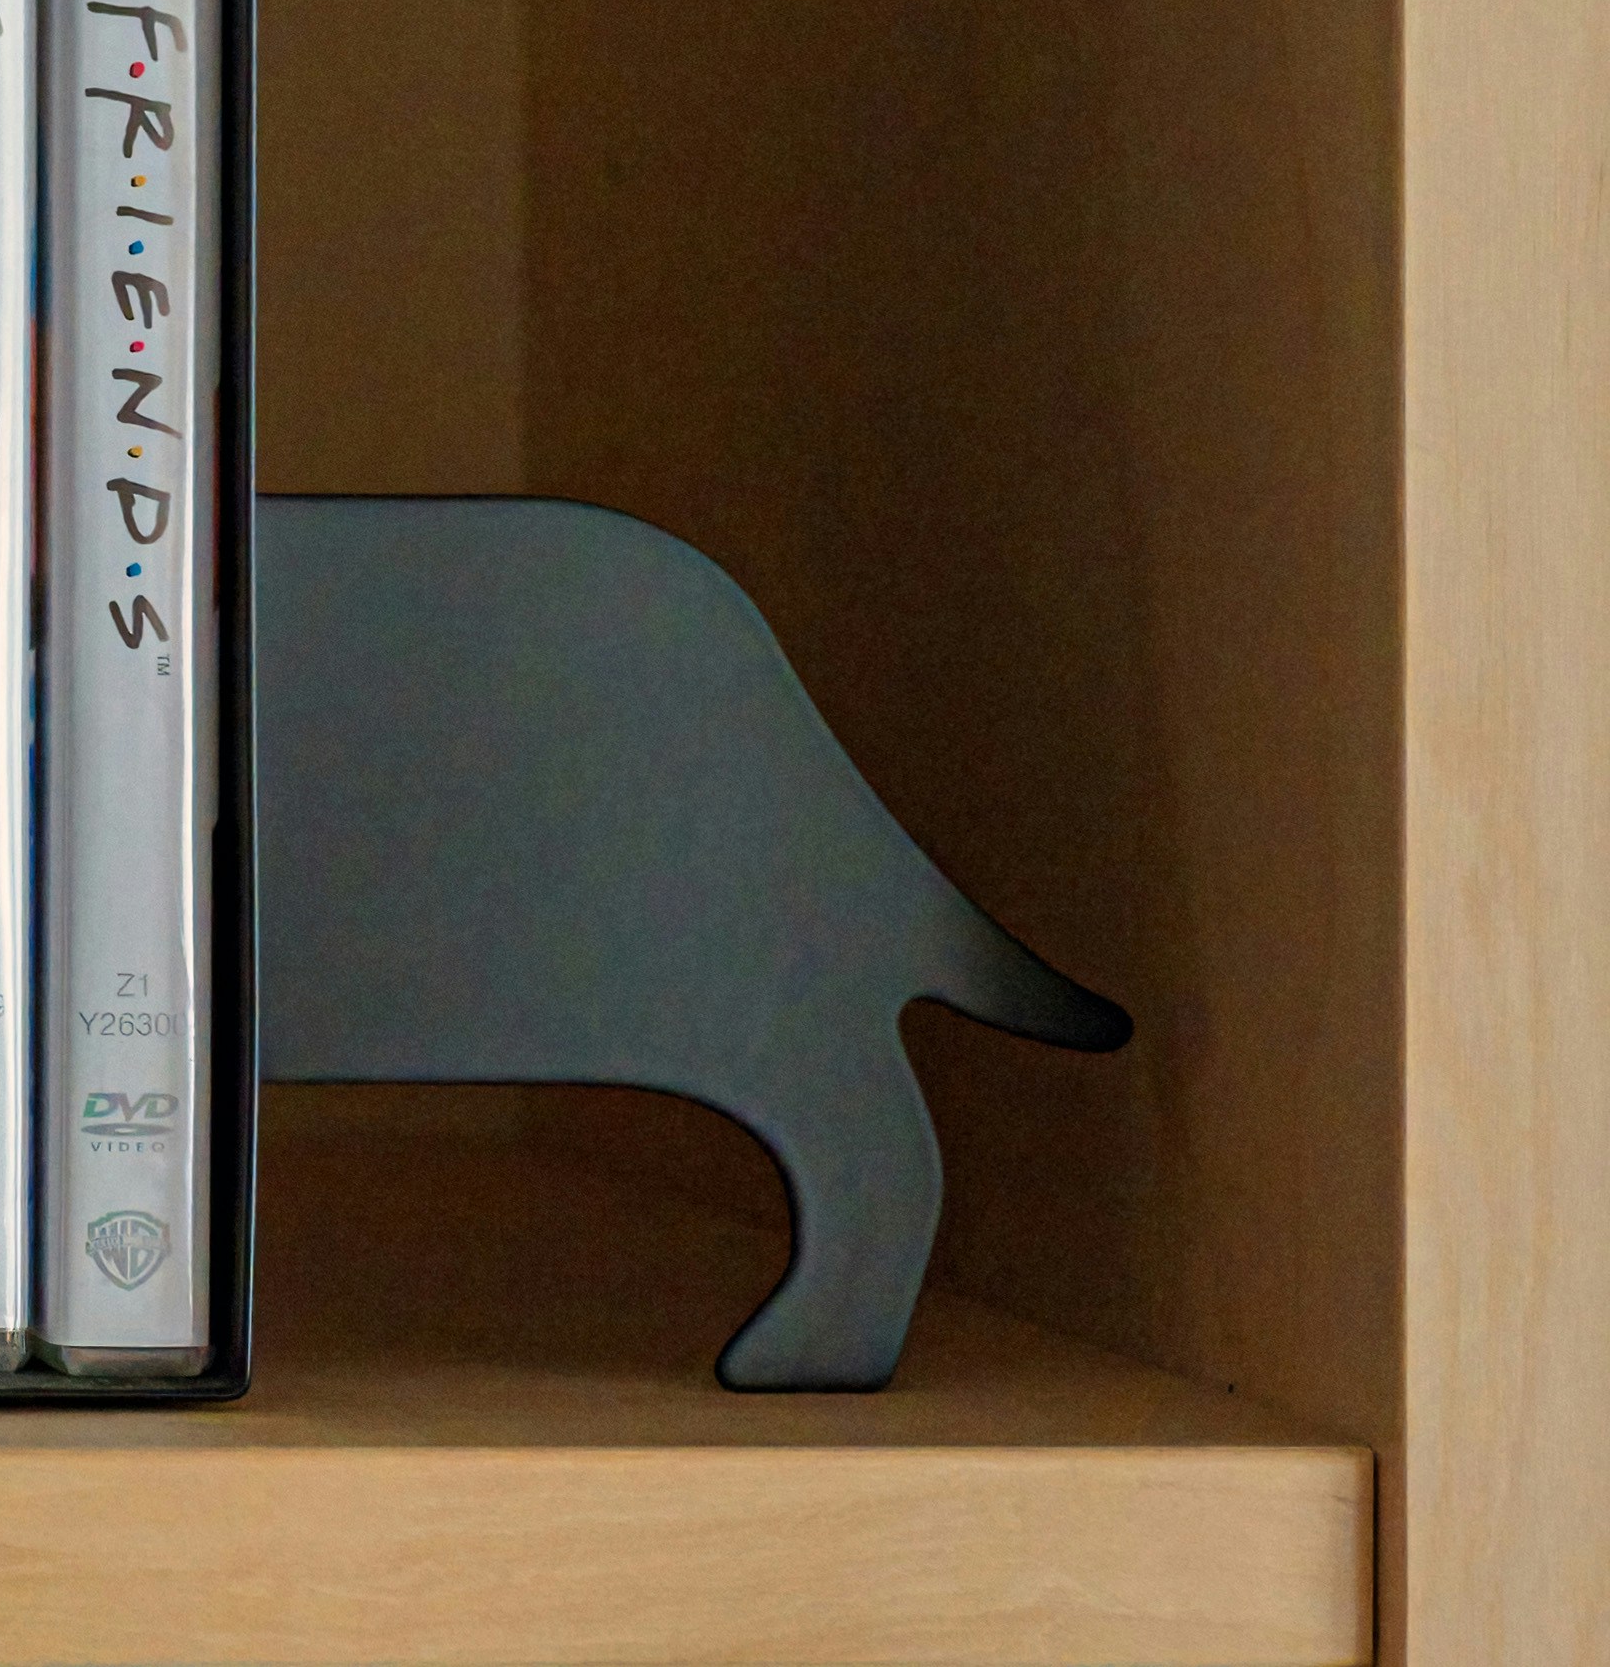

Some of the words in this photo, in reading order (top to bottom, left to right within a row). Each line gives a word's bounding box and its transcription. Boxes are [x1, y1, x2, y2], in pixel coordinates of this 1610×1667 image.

[117, 973, 148, 997] Z1
[83, 1093, 179, 1121] DVD
[91, 1142, 164, 1152] VIDEO
